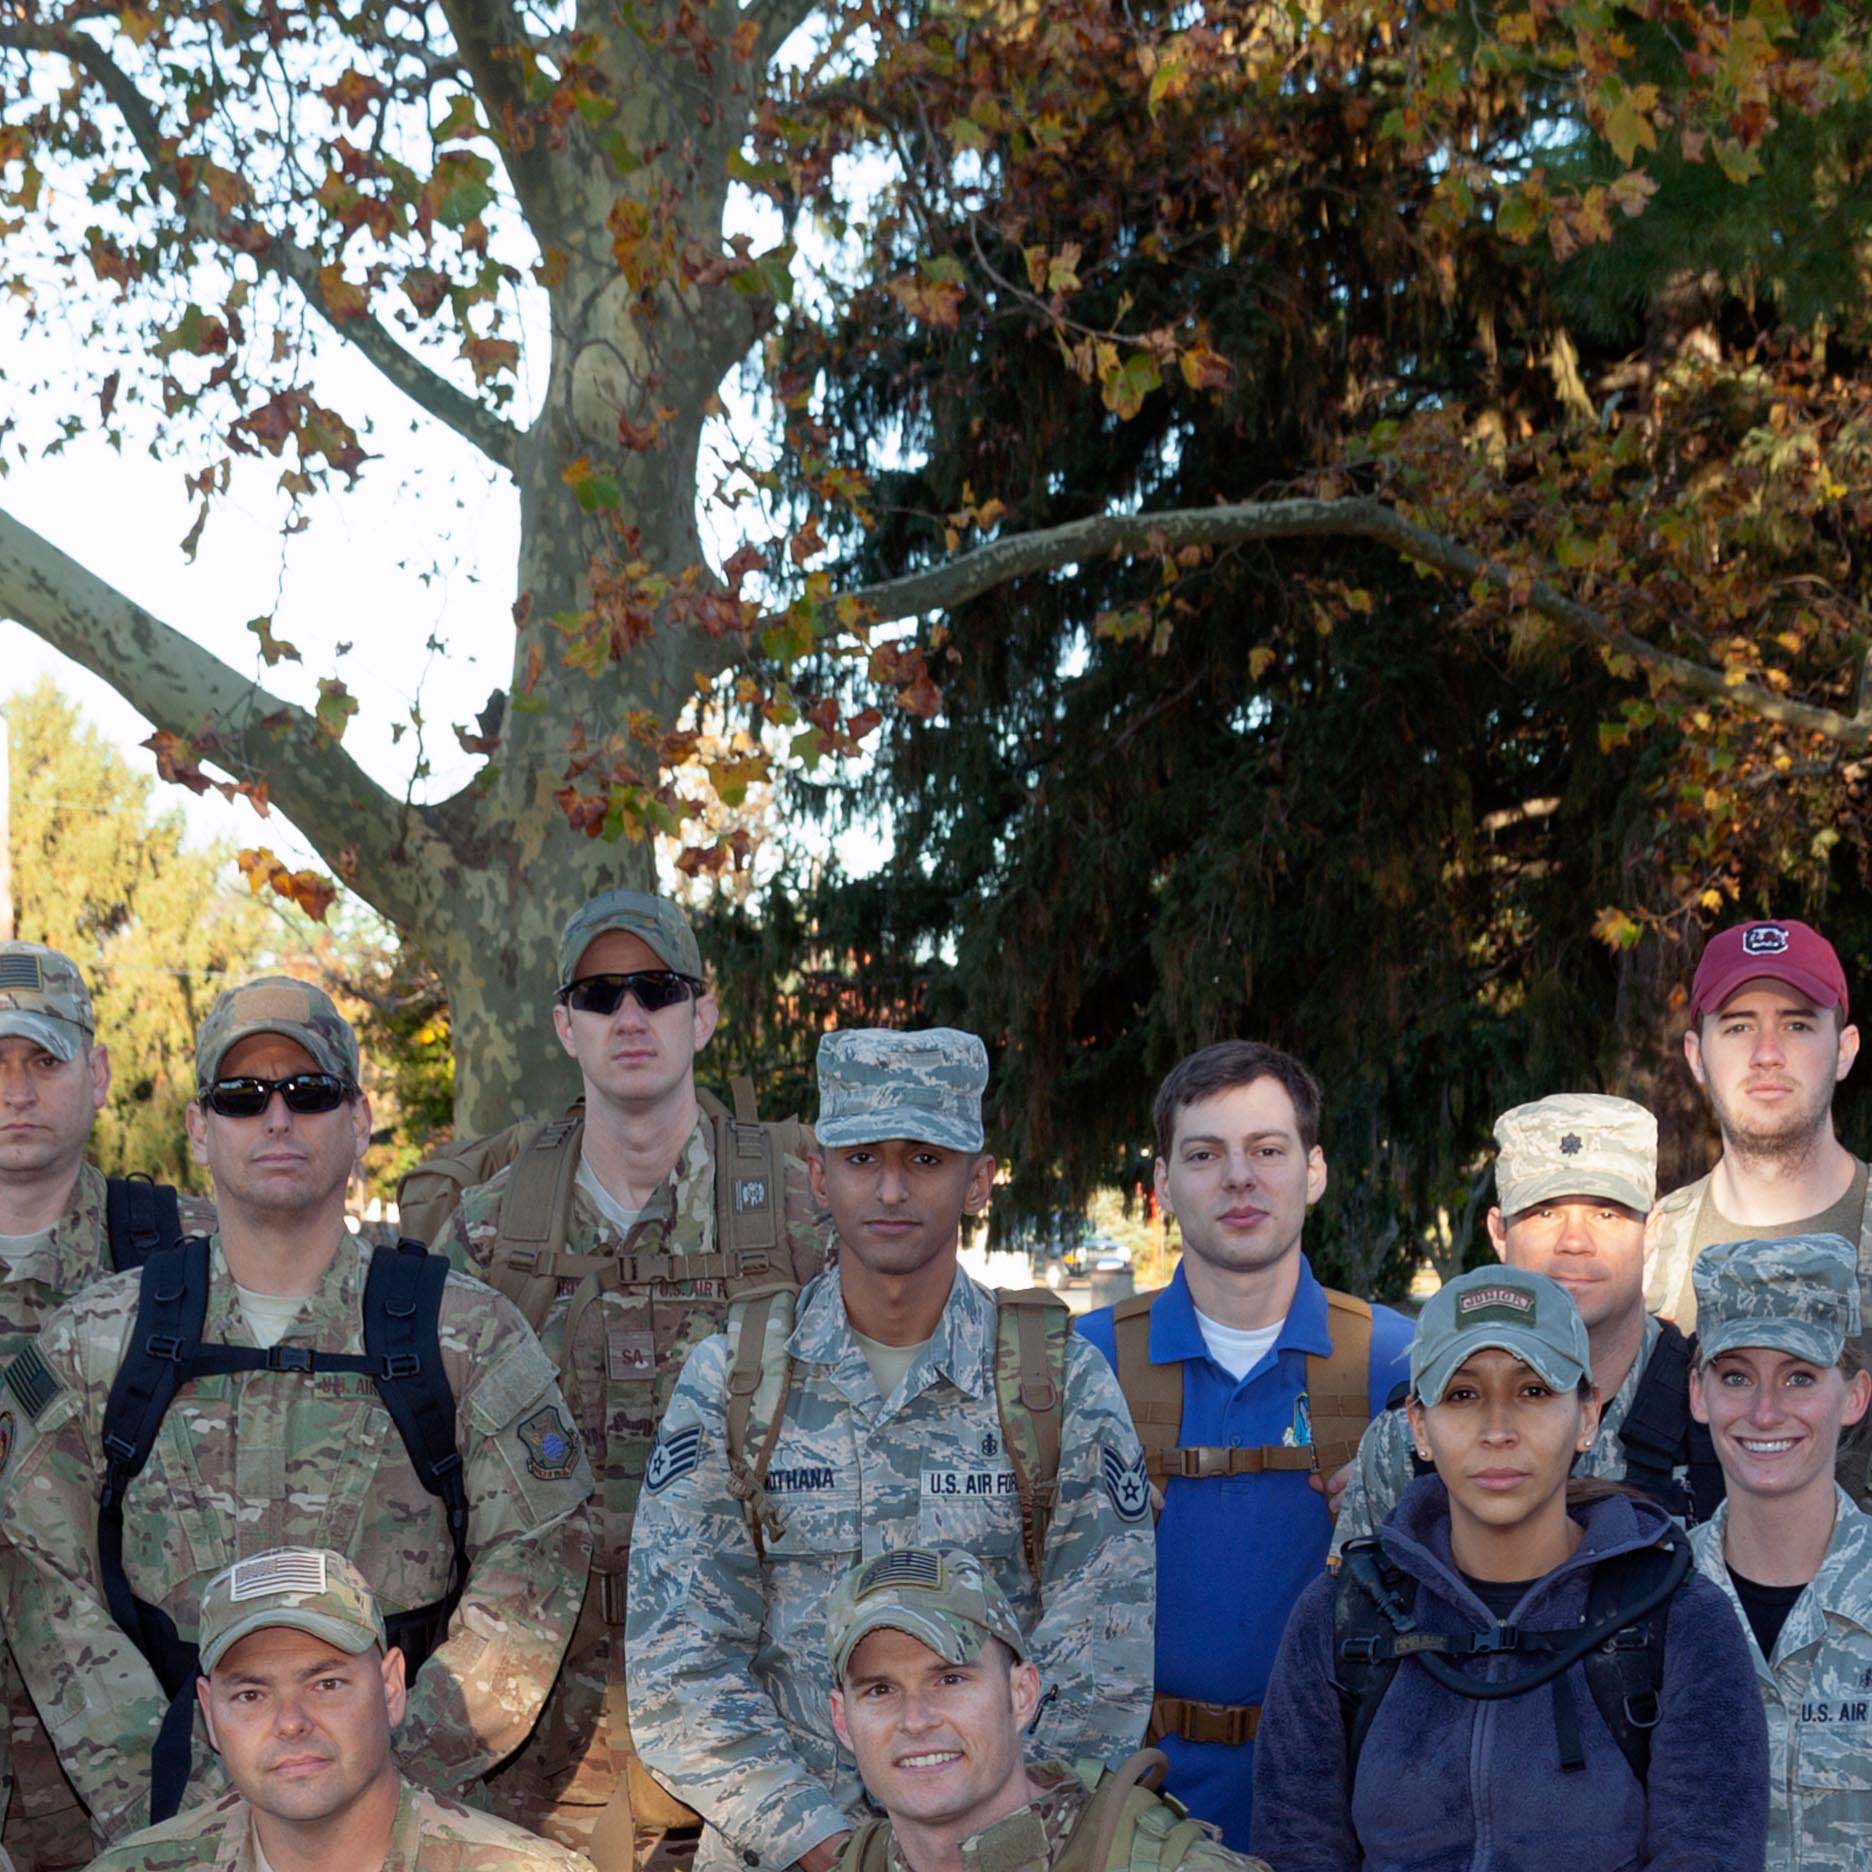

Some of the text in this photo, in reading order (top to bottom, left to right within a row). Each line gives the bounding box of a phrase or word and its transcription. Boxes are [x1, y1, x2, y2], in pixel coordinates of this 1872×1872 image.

[622, 1349, 644, 1365] SA
[930, 1473, 961, 1494] U.S.
[966, 1473, 992, 1494] AIR
[1802, 1703, 1833, 1722] U.S.
[1839, 1702, 1867, 1721] AIR
